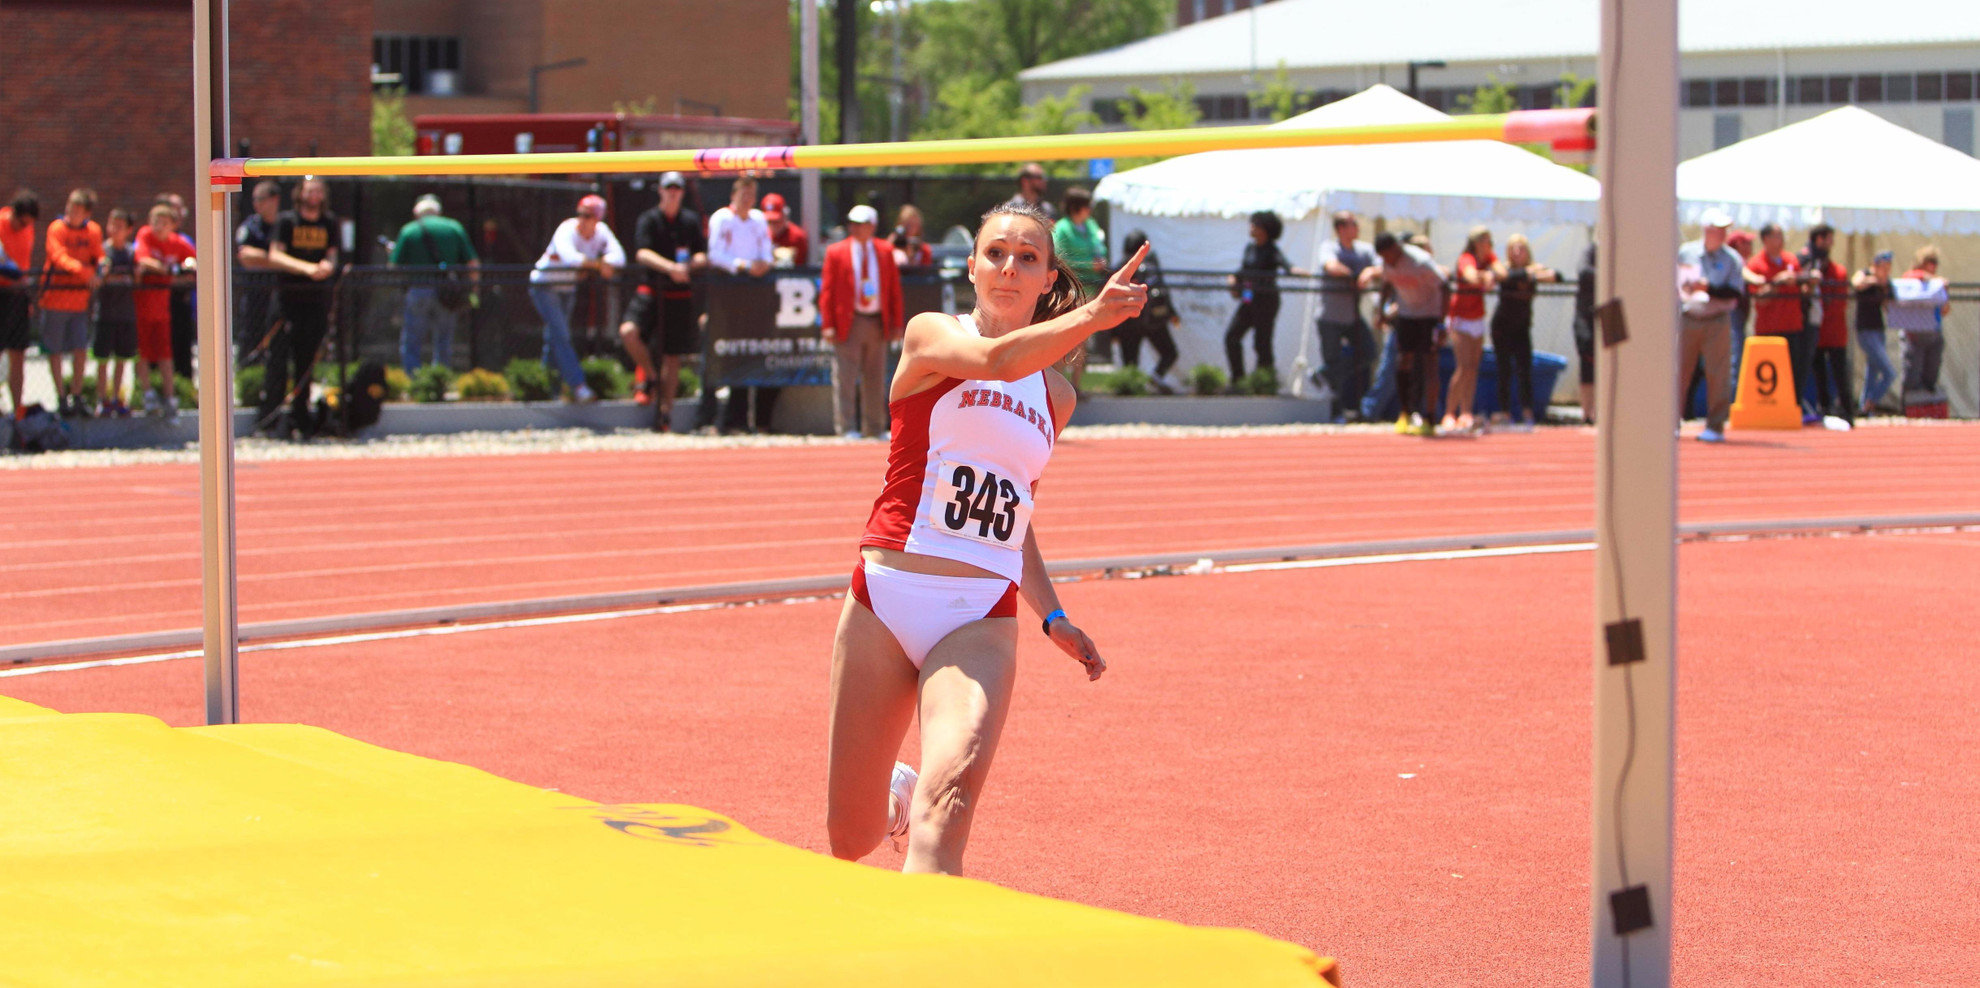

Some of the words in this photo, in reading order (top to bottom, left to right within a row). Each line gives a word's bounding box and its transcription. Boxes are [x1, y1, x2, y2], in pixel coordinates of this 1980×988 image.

[719, 148, 770, 169] GILL
[775, 277, 817, 328] B
[714, 338, 793, 355] OUTDOOR
[797, 337, 834, 353] TRA
[1756, 360, 1778, 396] 9
[944, 465, 1020, 542] 343
